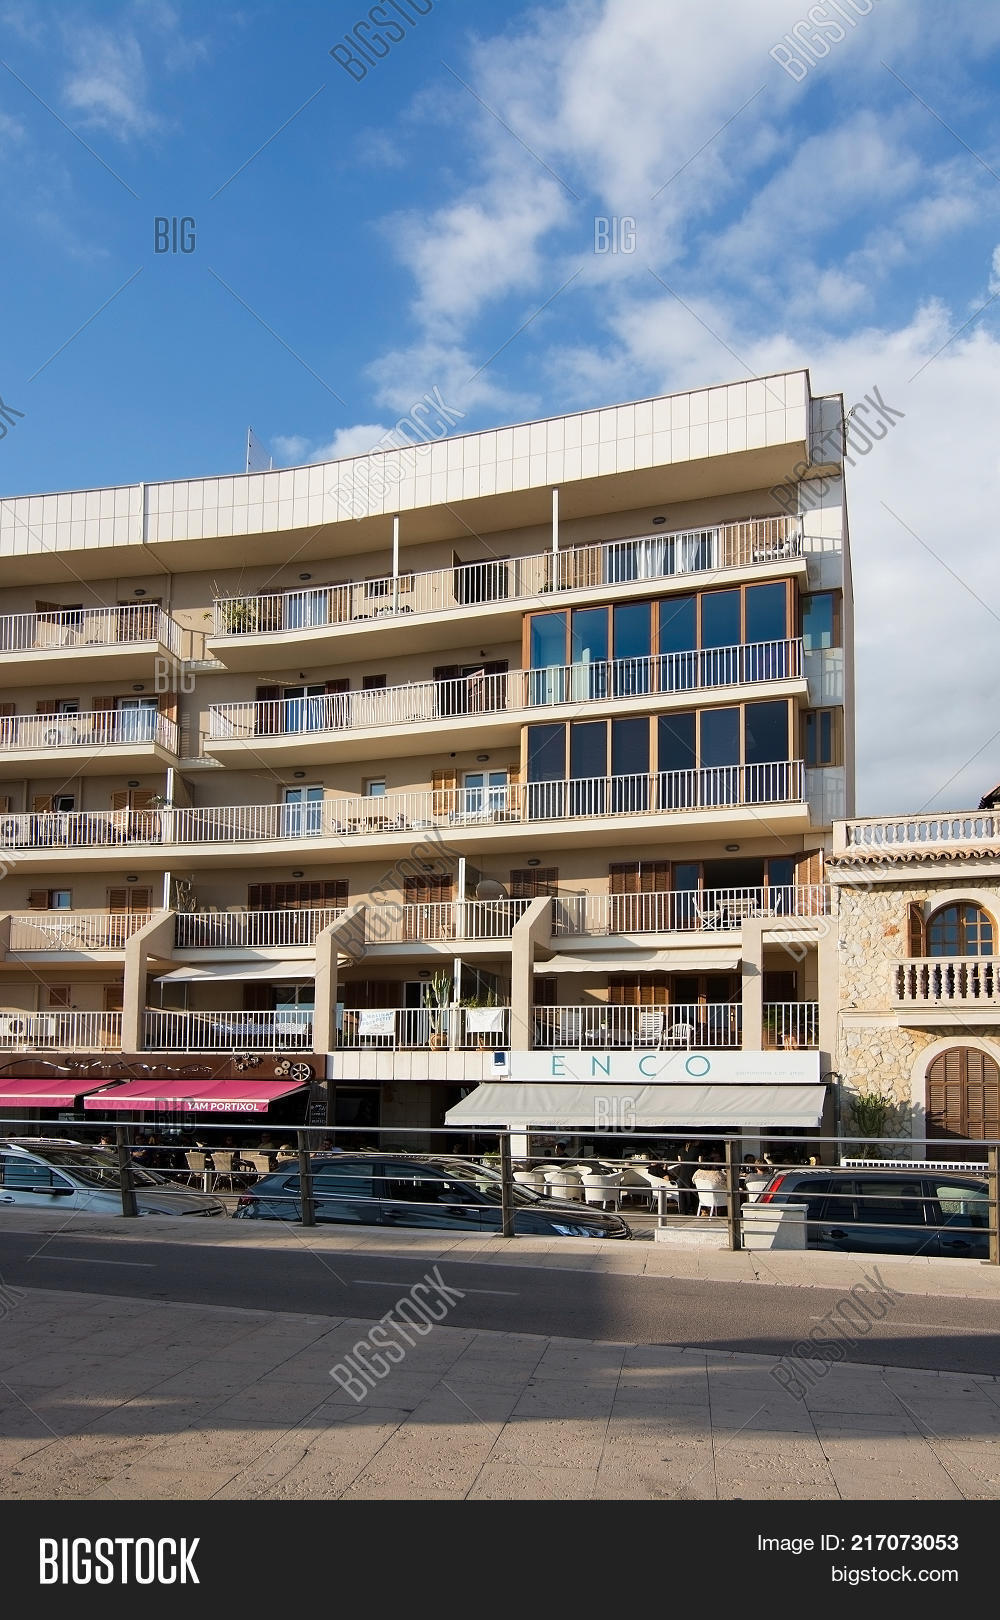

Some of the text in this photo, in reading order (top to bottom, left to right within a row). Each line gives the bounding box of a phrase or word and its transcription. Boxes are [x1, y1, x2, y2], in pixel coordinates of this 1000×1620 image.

[552, 1055, 711, 1077] ENCO
[187, 1102, 259, 1111] YAM PORTIXOL
